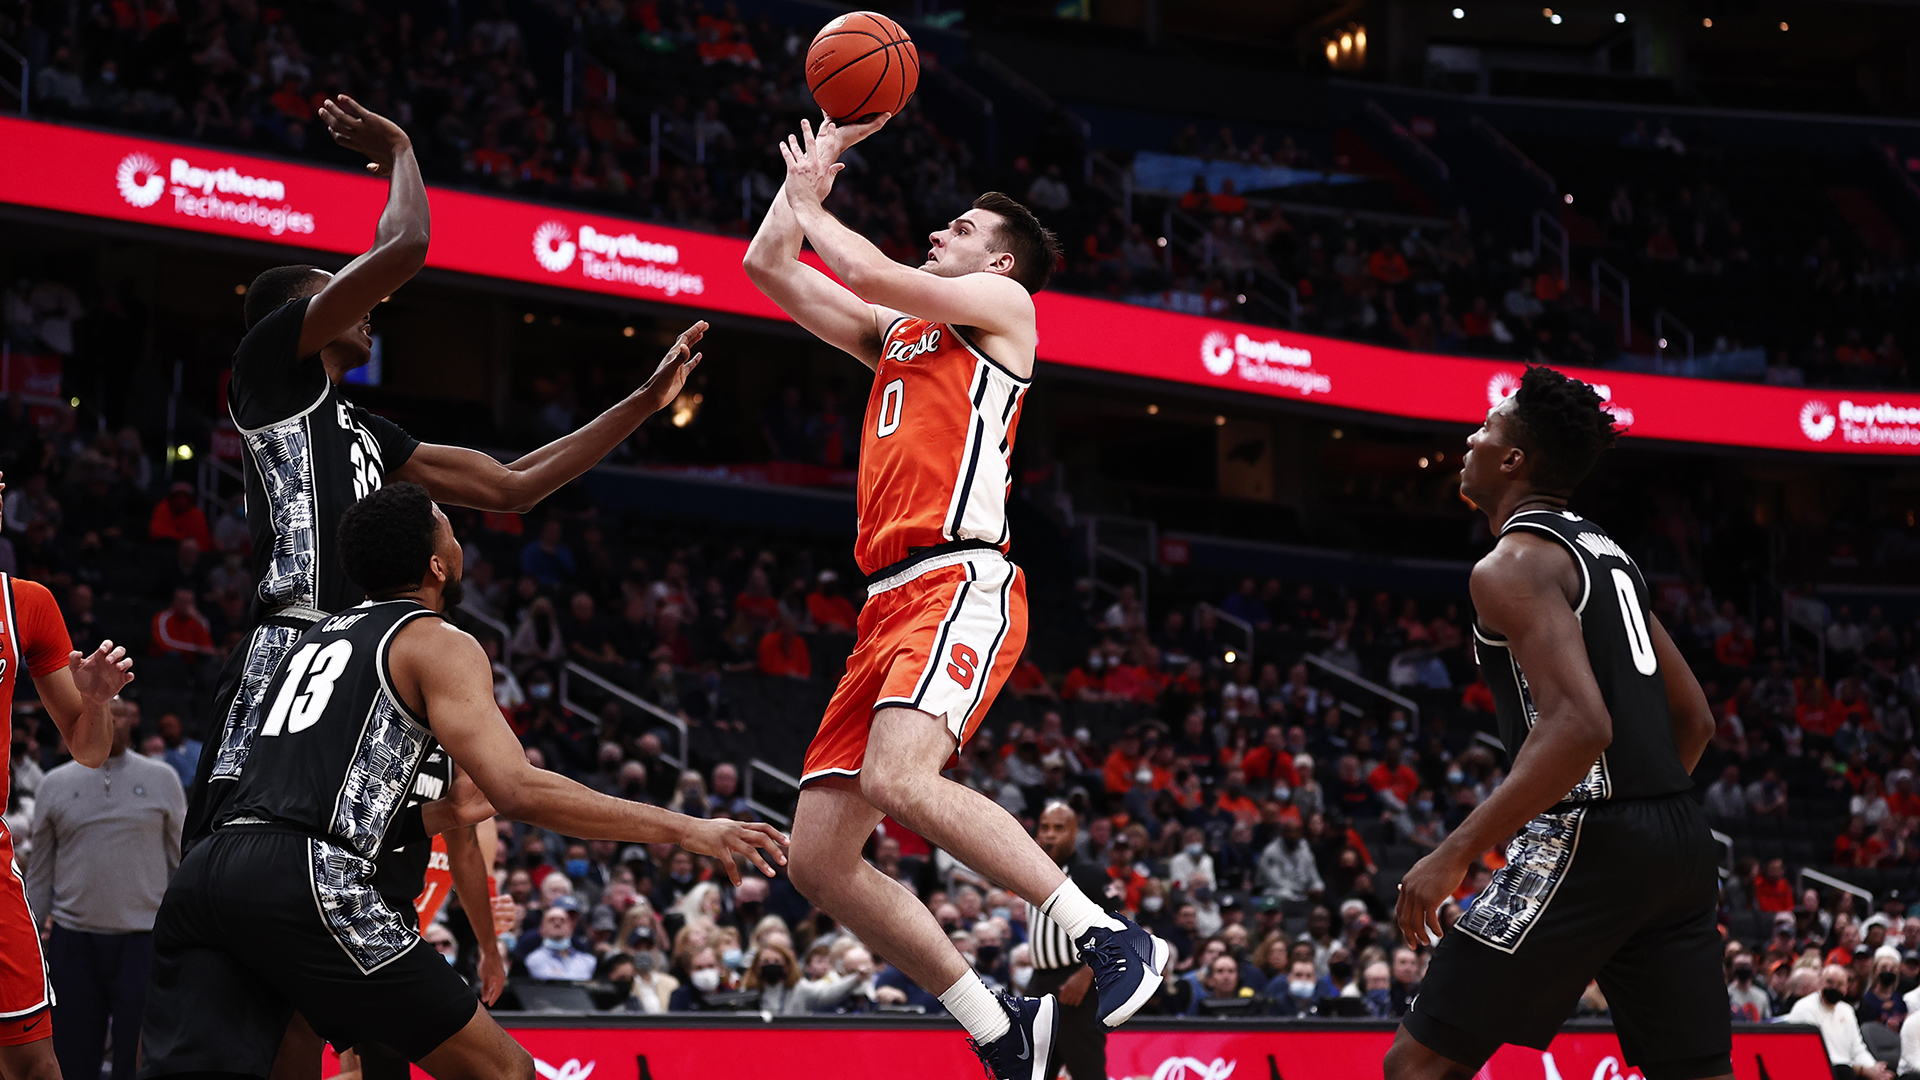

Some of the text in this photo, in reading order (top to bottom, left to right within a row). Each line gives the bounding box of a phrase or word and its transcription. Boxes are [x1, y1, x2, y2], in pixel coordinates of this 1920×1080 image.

[170, 158, 285, 201] Raytheon
[169, 186, 315, 236] Technologies
[578, 225, 679, 265] Raytheon
[578, 251, 704, 297] Technologies
[1235, 333, 1312, 368] Raytheon
[1236, 355, 1332, 396] Technologies
[877, 377, 905, 439] 0
[1838, 400, 1920, 426] Raytheo
[1839, 420, 1920, 446] Technolo
[1610, 567, 1658, 677] 0
[259, 638, 353, 737] 13
[946, 642, 979, 690] S
